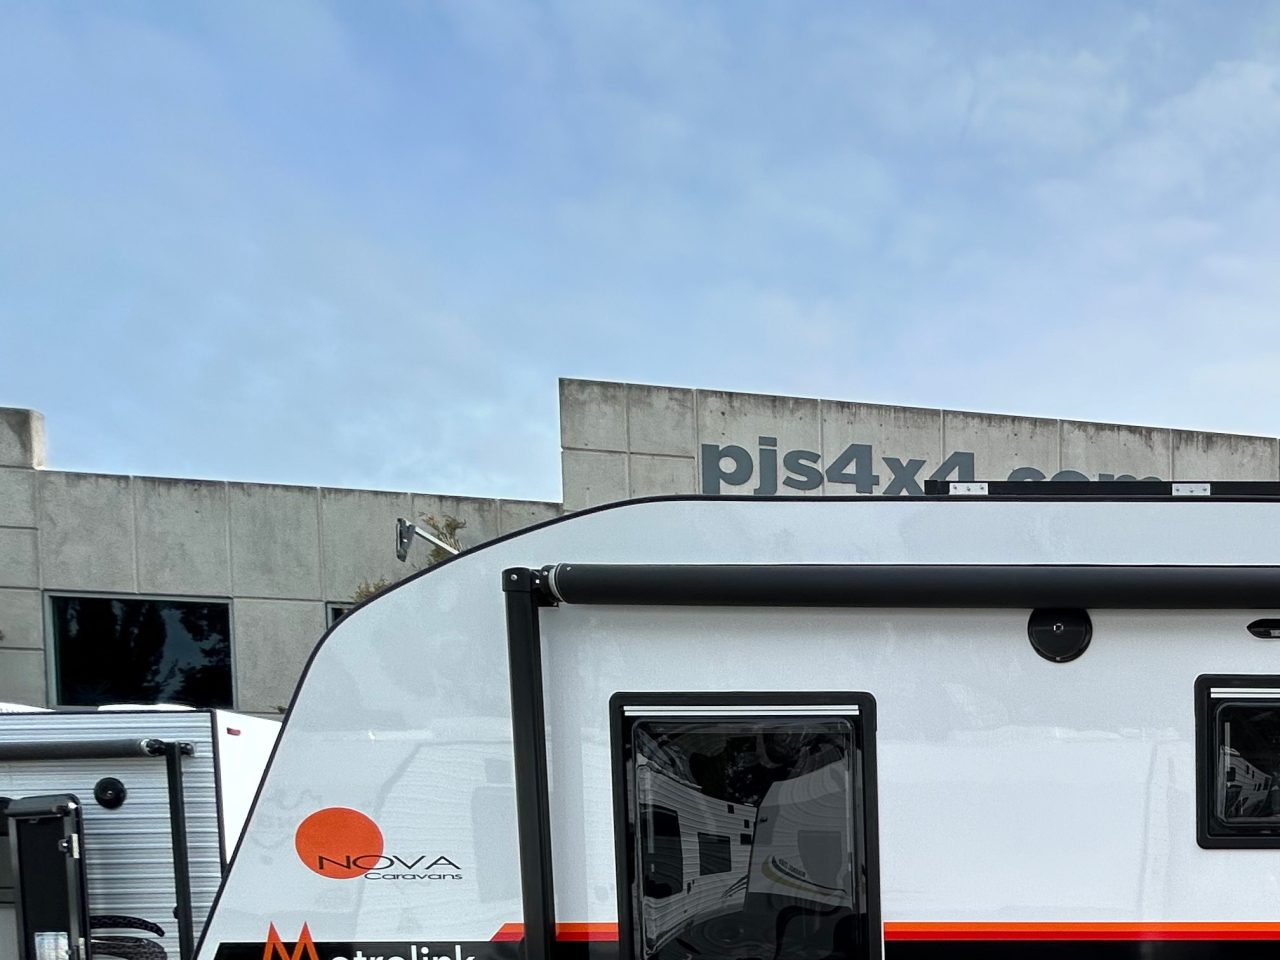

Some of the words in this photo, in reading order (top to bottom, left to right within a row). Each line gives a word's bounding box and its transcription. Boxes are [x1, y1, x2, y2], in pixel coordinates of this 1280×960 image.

[701, 436, 1163, 496] pjs4x4
[318, 855, 462, 870] NOVA
[365, 872, 463, 880] Caravans
